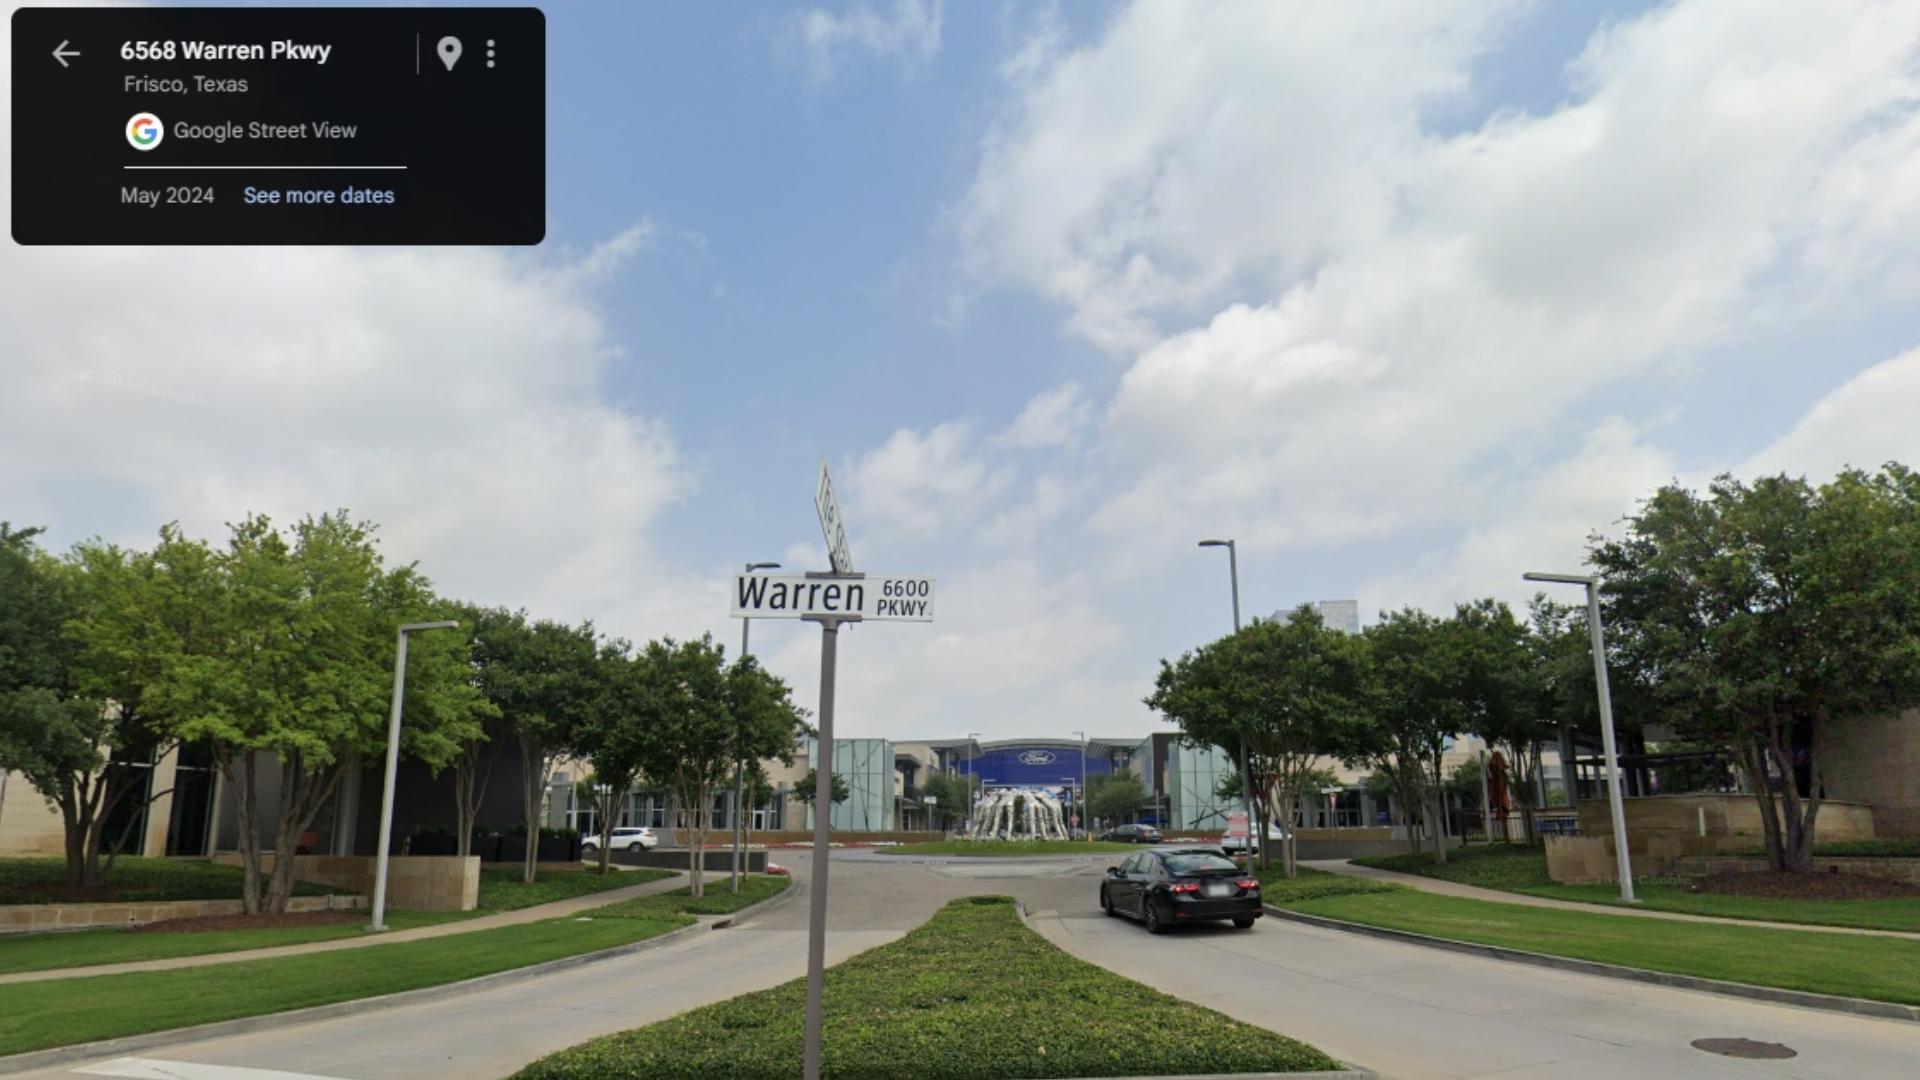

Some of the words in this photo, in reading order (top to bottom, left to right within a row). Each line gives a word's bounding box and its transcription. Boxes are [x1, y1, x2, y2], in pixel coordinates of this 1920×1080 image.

[738, 576, 865, 611] Warren
[882, 579, 929, 597] 6600
[877, 599, 928, 616] PKWY
[1023, 750, 1050, 764] Ford
